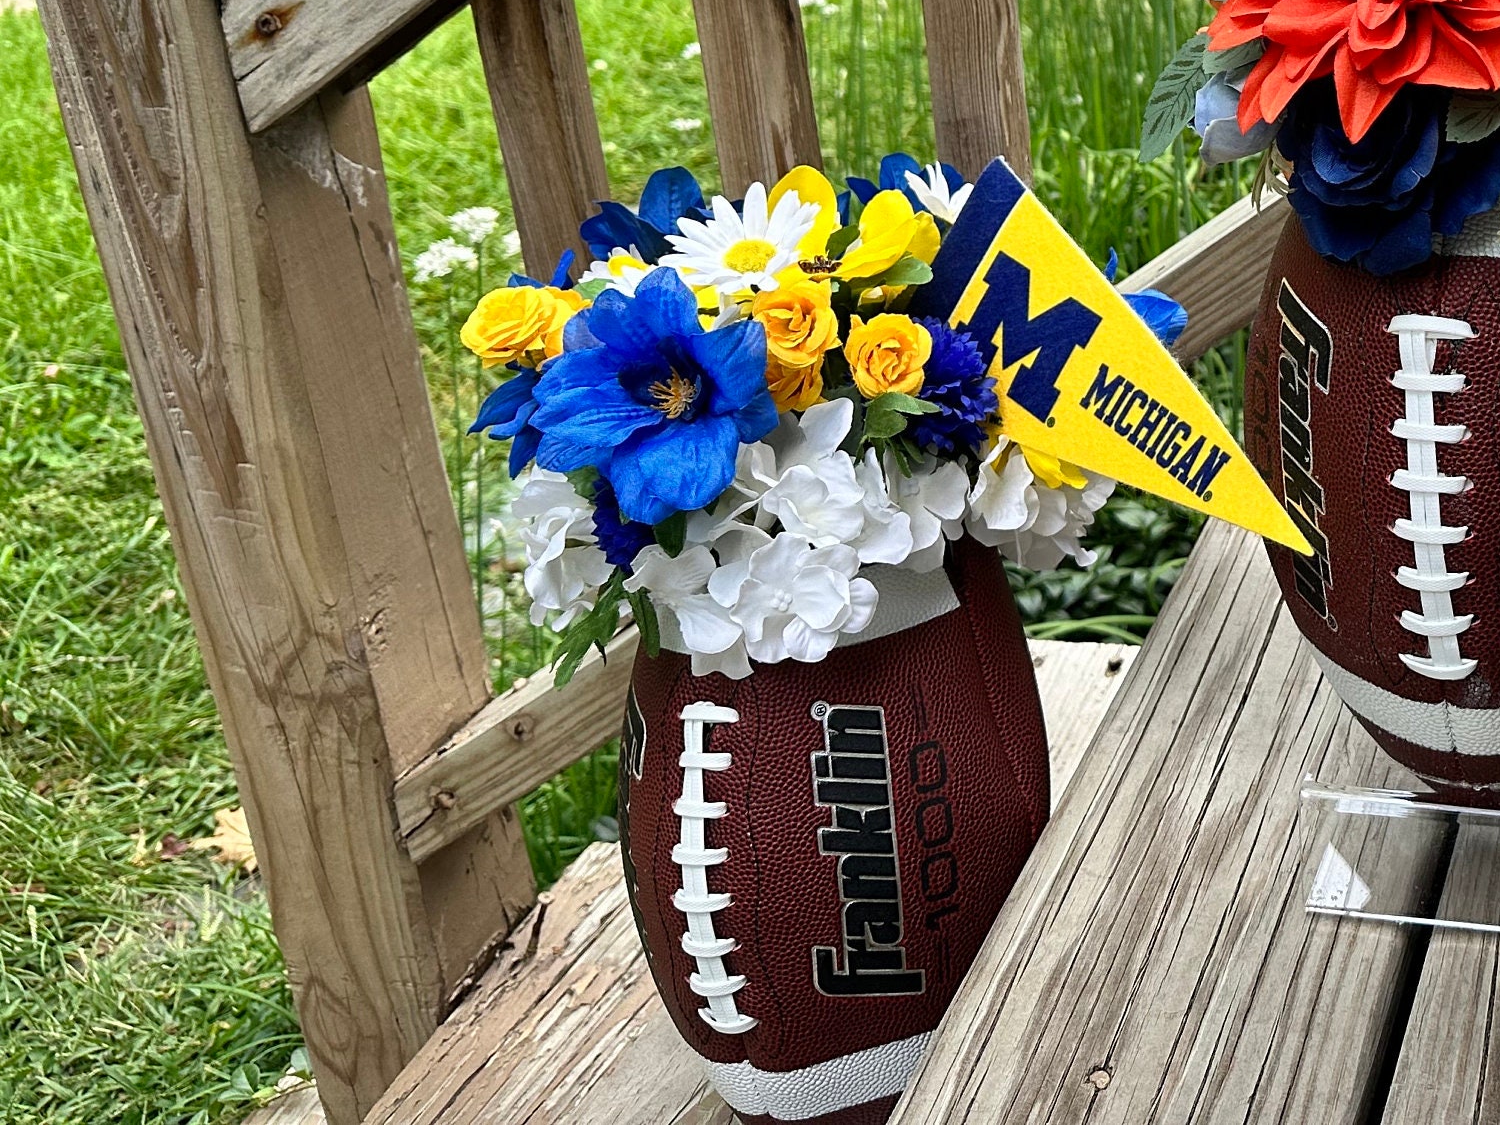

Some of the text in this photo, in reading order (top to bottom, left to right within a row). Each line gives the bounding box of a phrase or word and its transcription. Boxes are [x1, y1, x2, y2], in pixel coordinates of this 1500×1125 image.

[957, 250, 1103, 424] M
[1079, 363, 1233, 500] MICHIGAN
[909, 738, 960, 932] 1000
